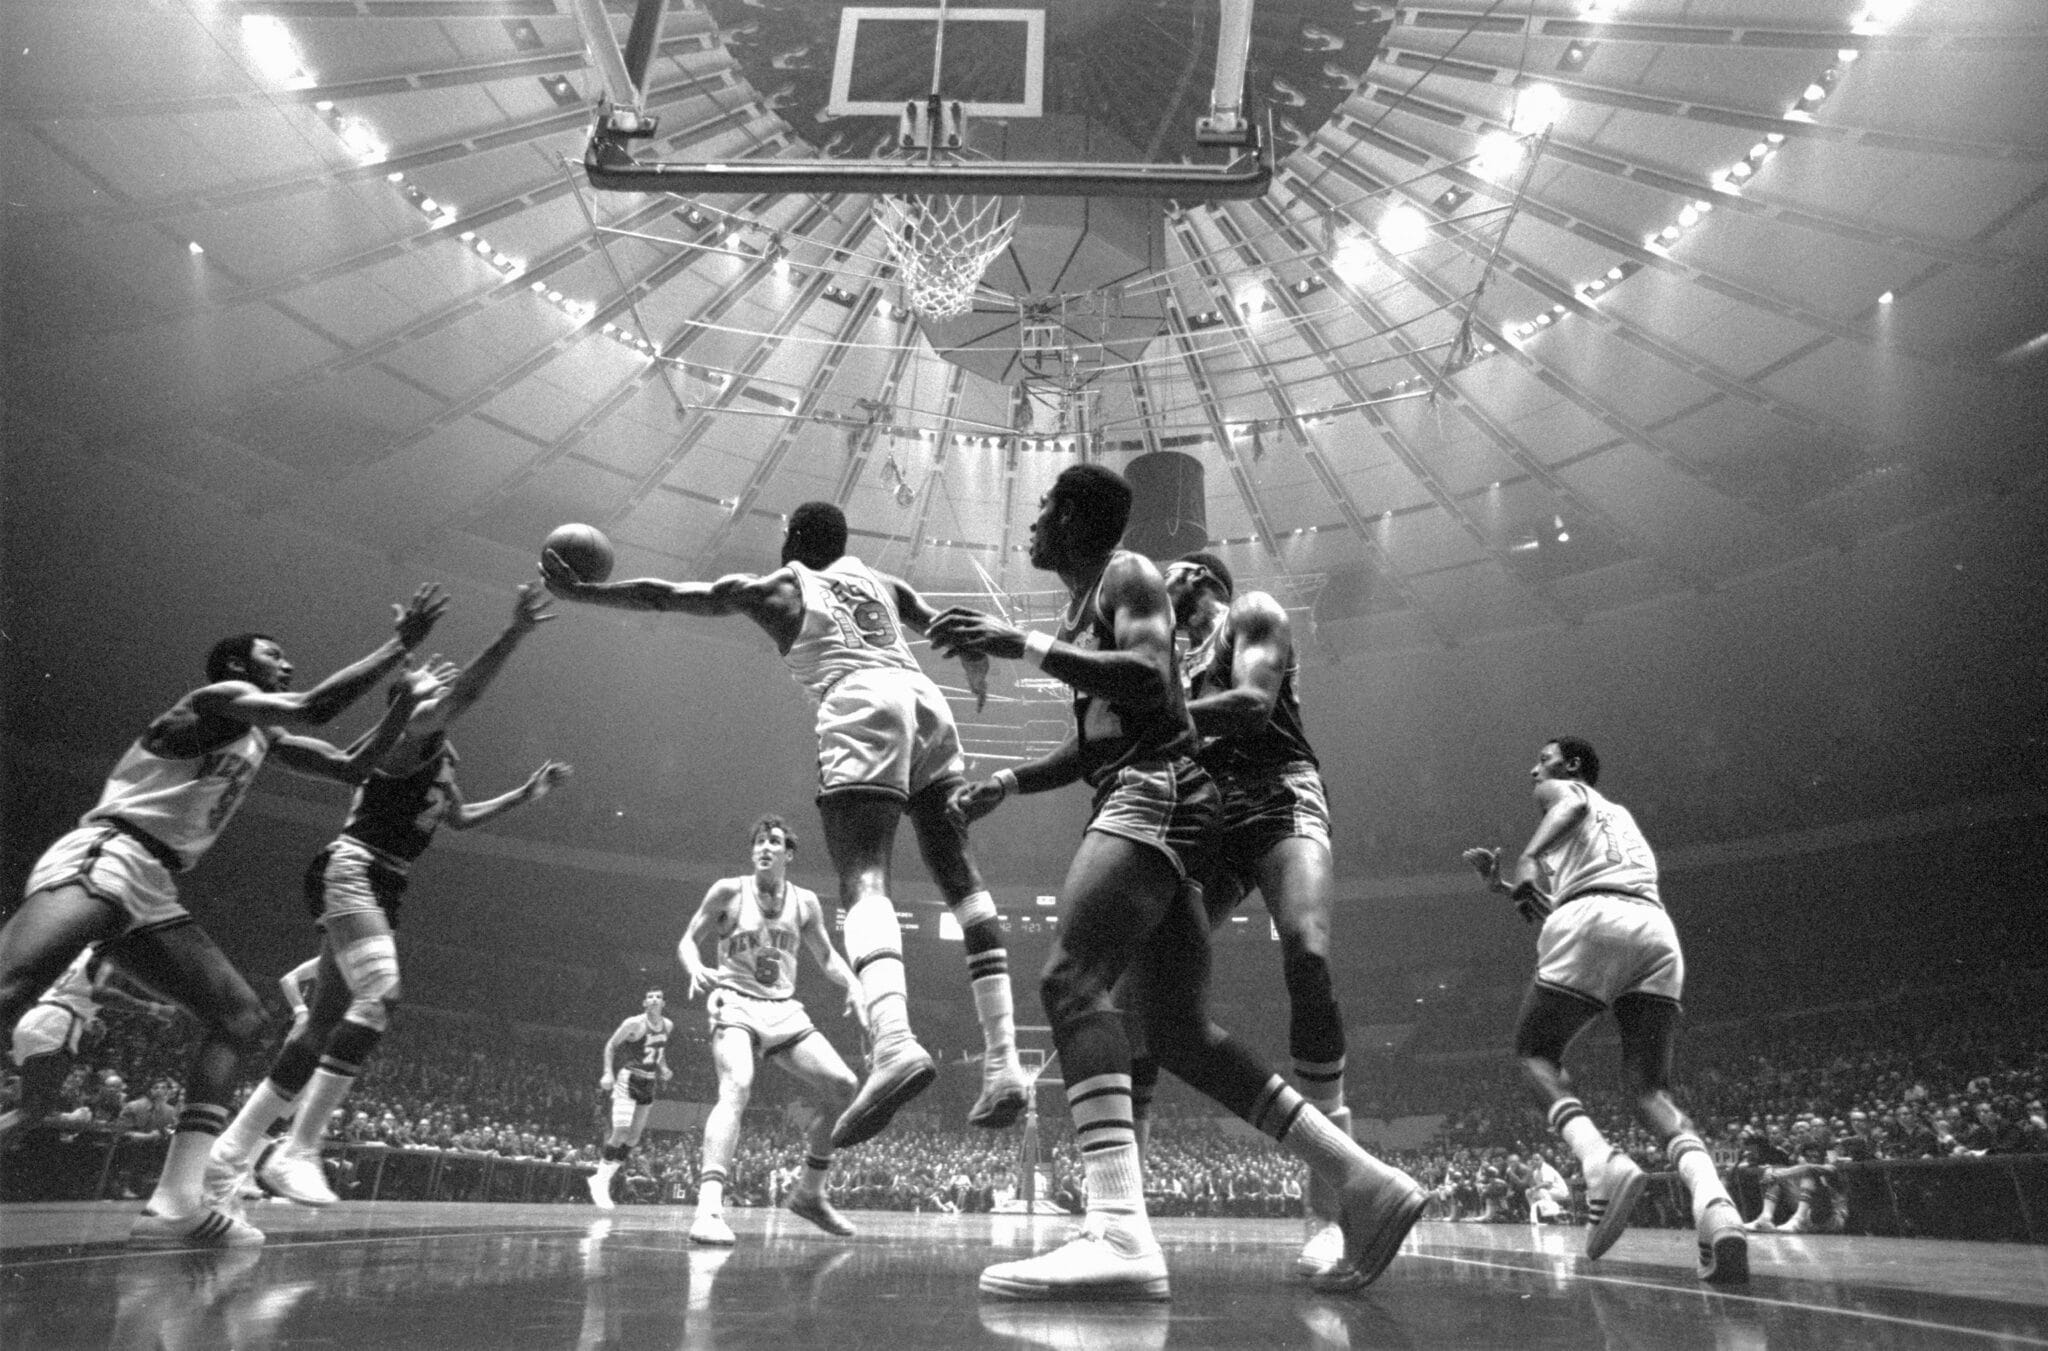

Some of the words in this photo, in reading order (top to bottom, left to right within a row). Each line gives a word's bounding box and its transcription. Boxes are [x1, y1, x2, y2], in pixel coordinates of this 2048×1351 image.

[832, 600, 897, 649] 19
[754, 947, 781, 988] 6
[642, 1047, 665, 1064] 21
